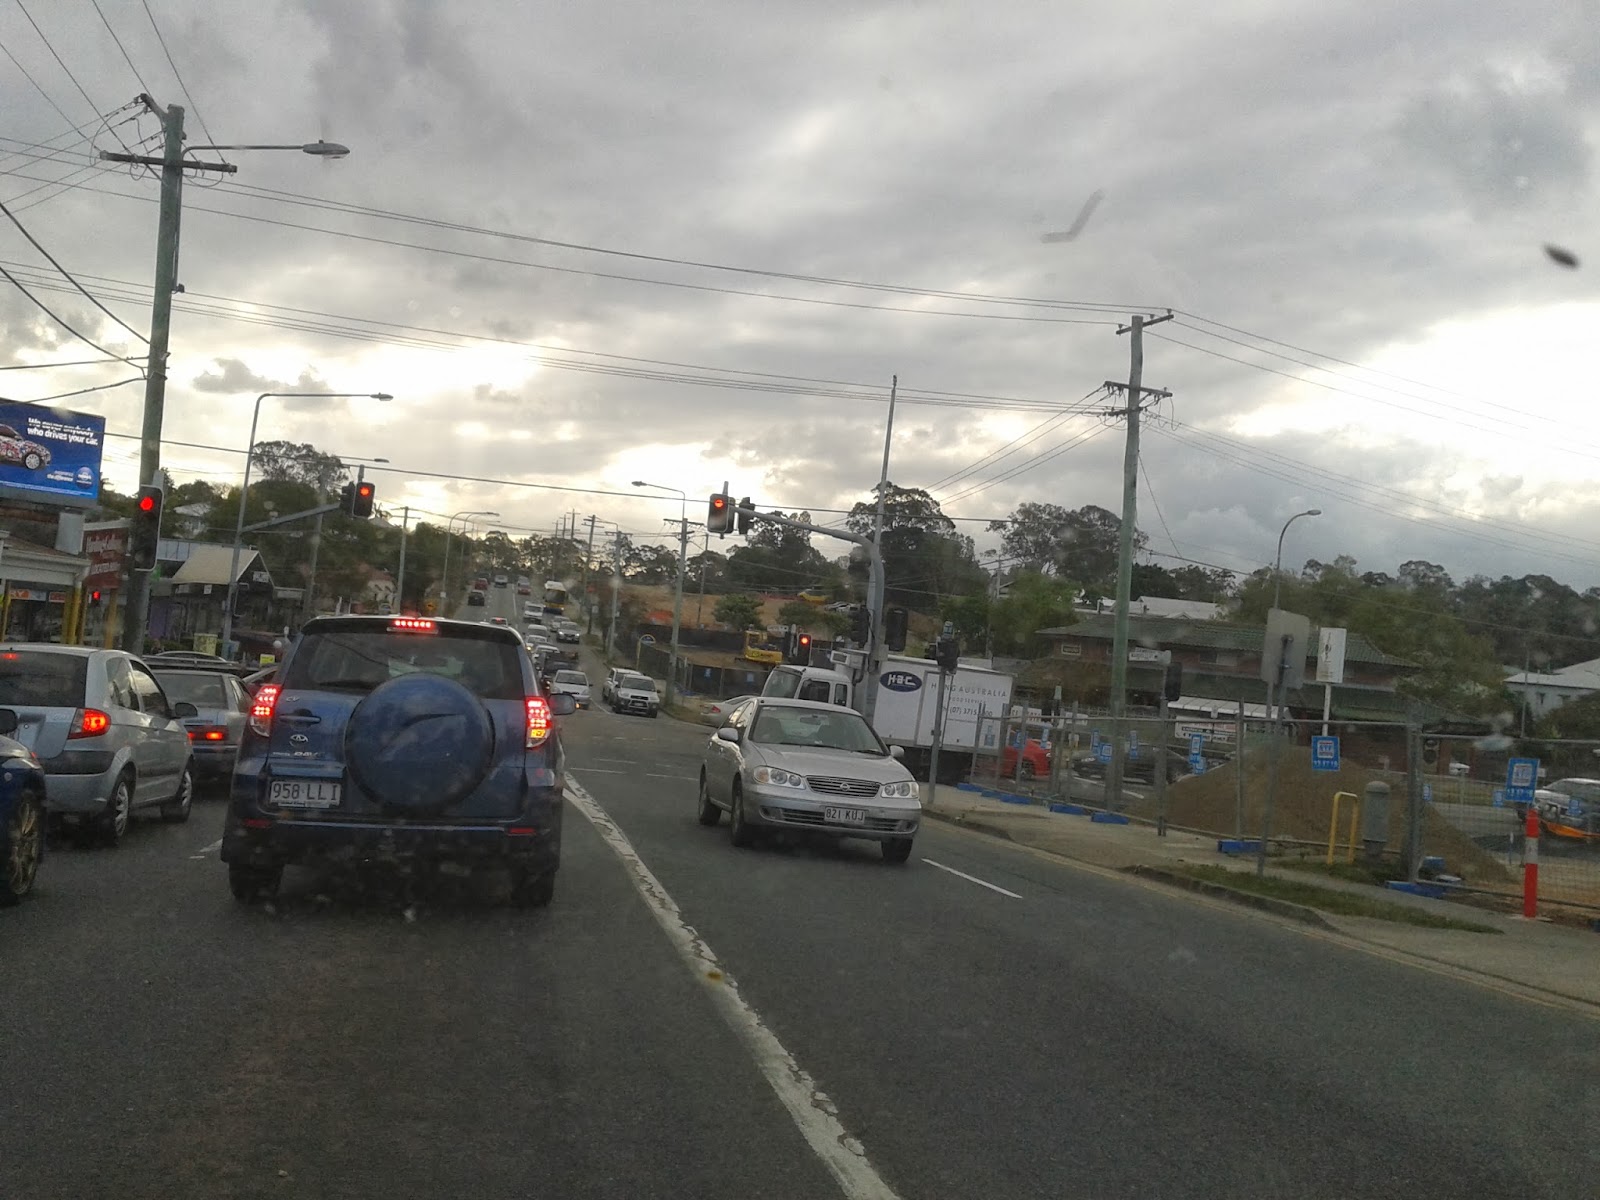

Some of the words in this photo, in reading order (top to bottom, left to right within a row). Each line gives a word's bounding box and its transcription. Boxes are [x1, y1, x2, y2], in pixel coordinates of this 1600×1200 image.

[931, 682, 956, 692] HNG
[958, 686, 1006, 697] AUSTRALIA
[273, 783, 300, 799] 958
[826, 808, 841, 819] 821
